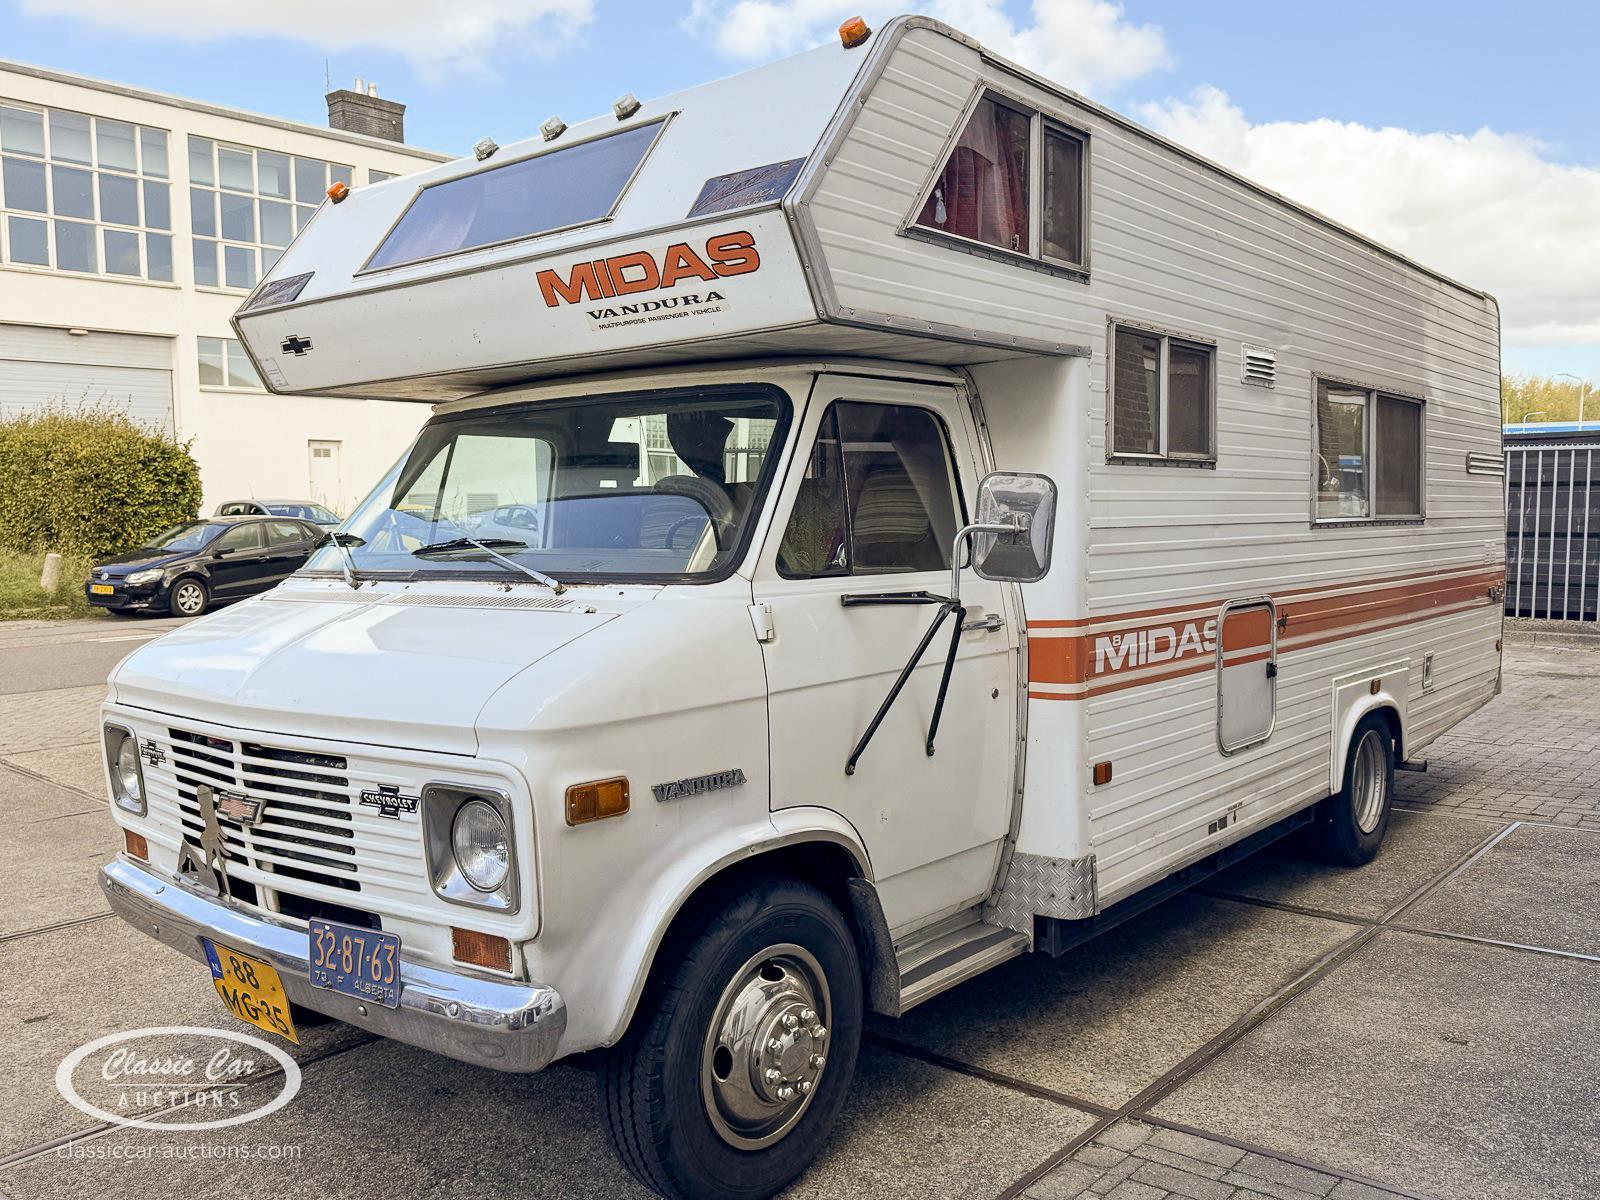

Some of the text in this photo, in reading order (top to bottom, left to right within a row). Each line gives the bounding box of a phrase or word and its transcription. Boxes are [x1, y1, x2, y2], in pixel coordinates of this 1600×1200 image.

[535, 230, 761, 308] MIDAS
[586, 291, 727, 320] VANDURA
[598, 306, 722, 330] MULTIPURPOSE PASSENGER VEHICLE
[1095, 619, 1218, 674] MIDAS
[651, 768, 748, 803] VANDURA
[363, 793, 414, 809] CHEVROLET
[354, 979, 394, 1000] ALBERTA
